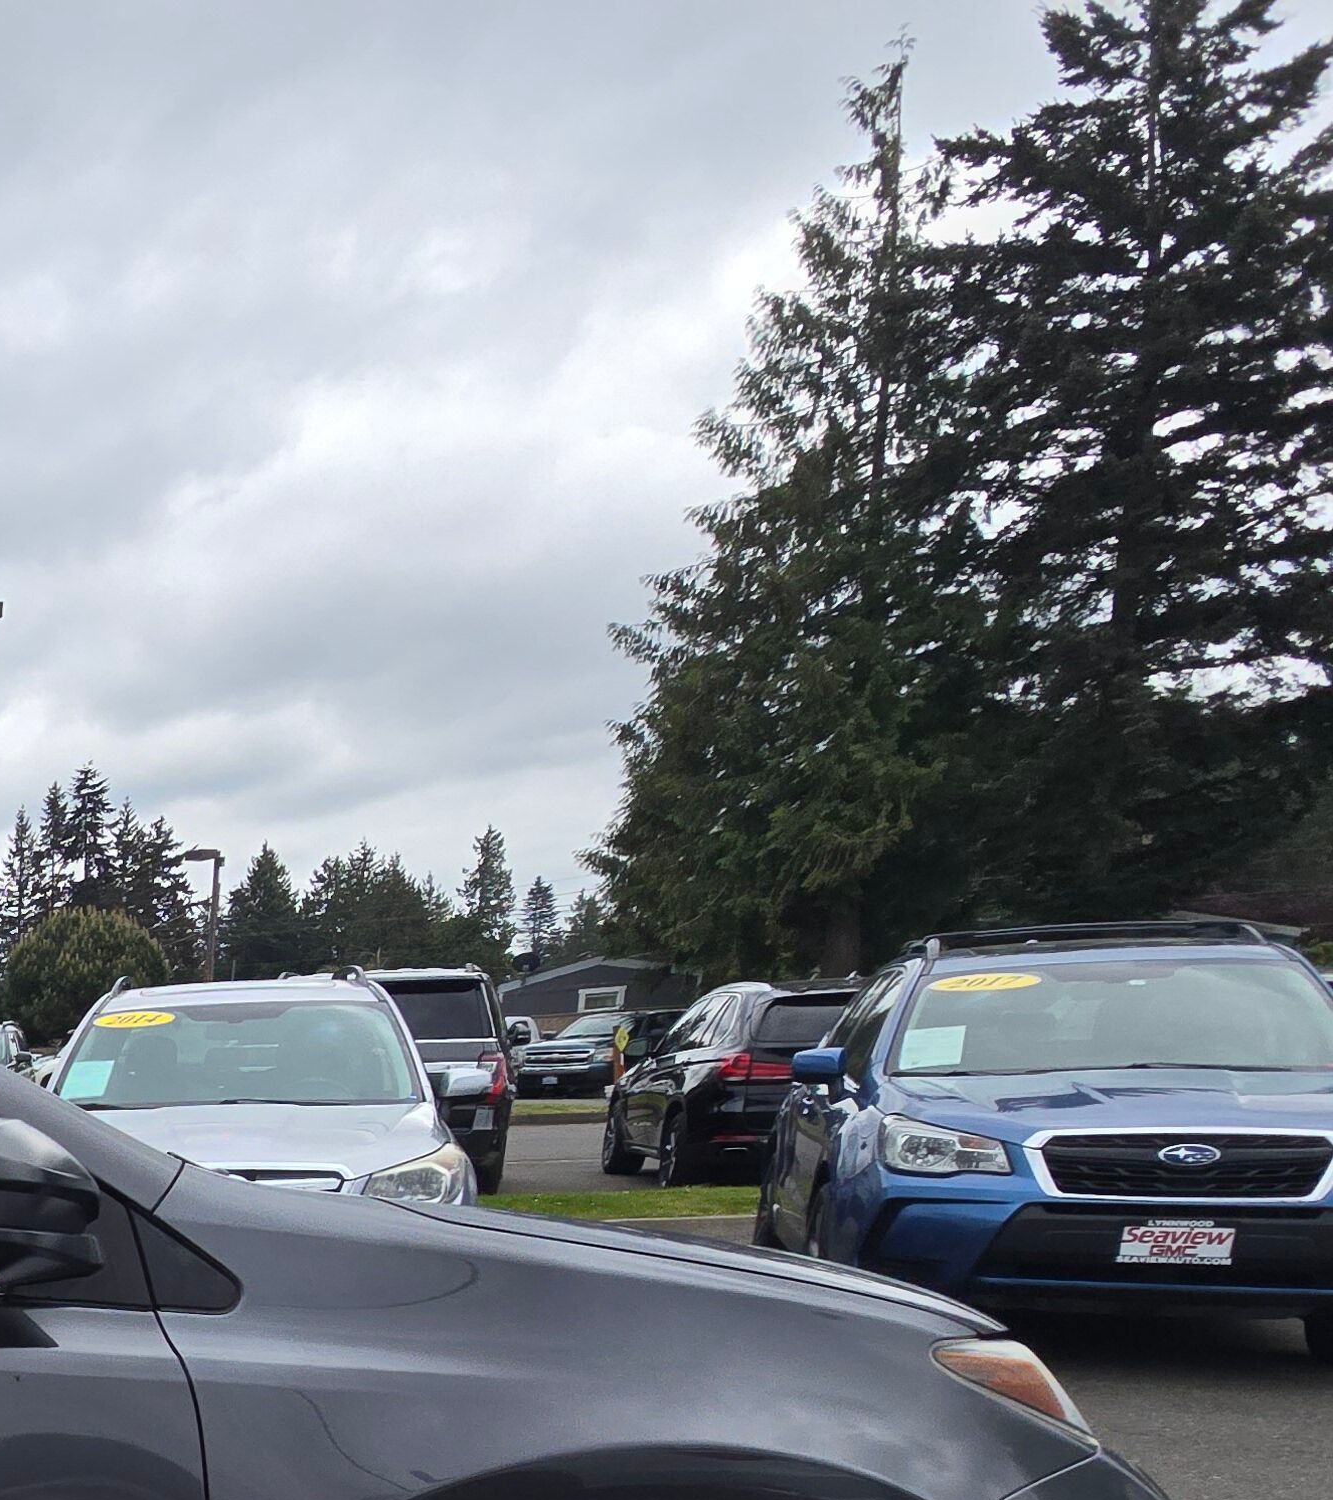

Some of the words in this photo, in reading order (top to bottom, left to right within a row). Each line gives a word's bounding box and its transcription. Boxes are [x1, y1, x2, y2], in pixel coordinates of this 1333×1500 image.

[946, 975, 1024, 989] 2017
[105, 1013, 163, 1026] 2014
[1147, 1219, 1215, 1227] LYNNWOOD
[1121, 1227, 1233, 1245] Seaview
[1149, 1244, 1198, 1257] GMC
[1115, 1255, 1232, 1266] SEAVIEWAUTO.COM
